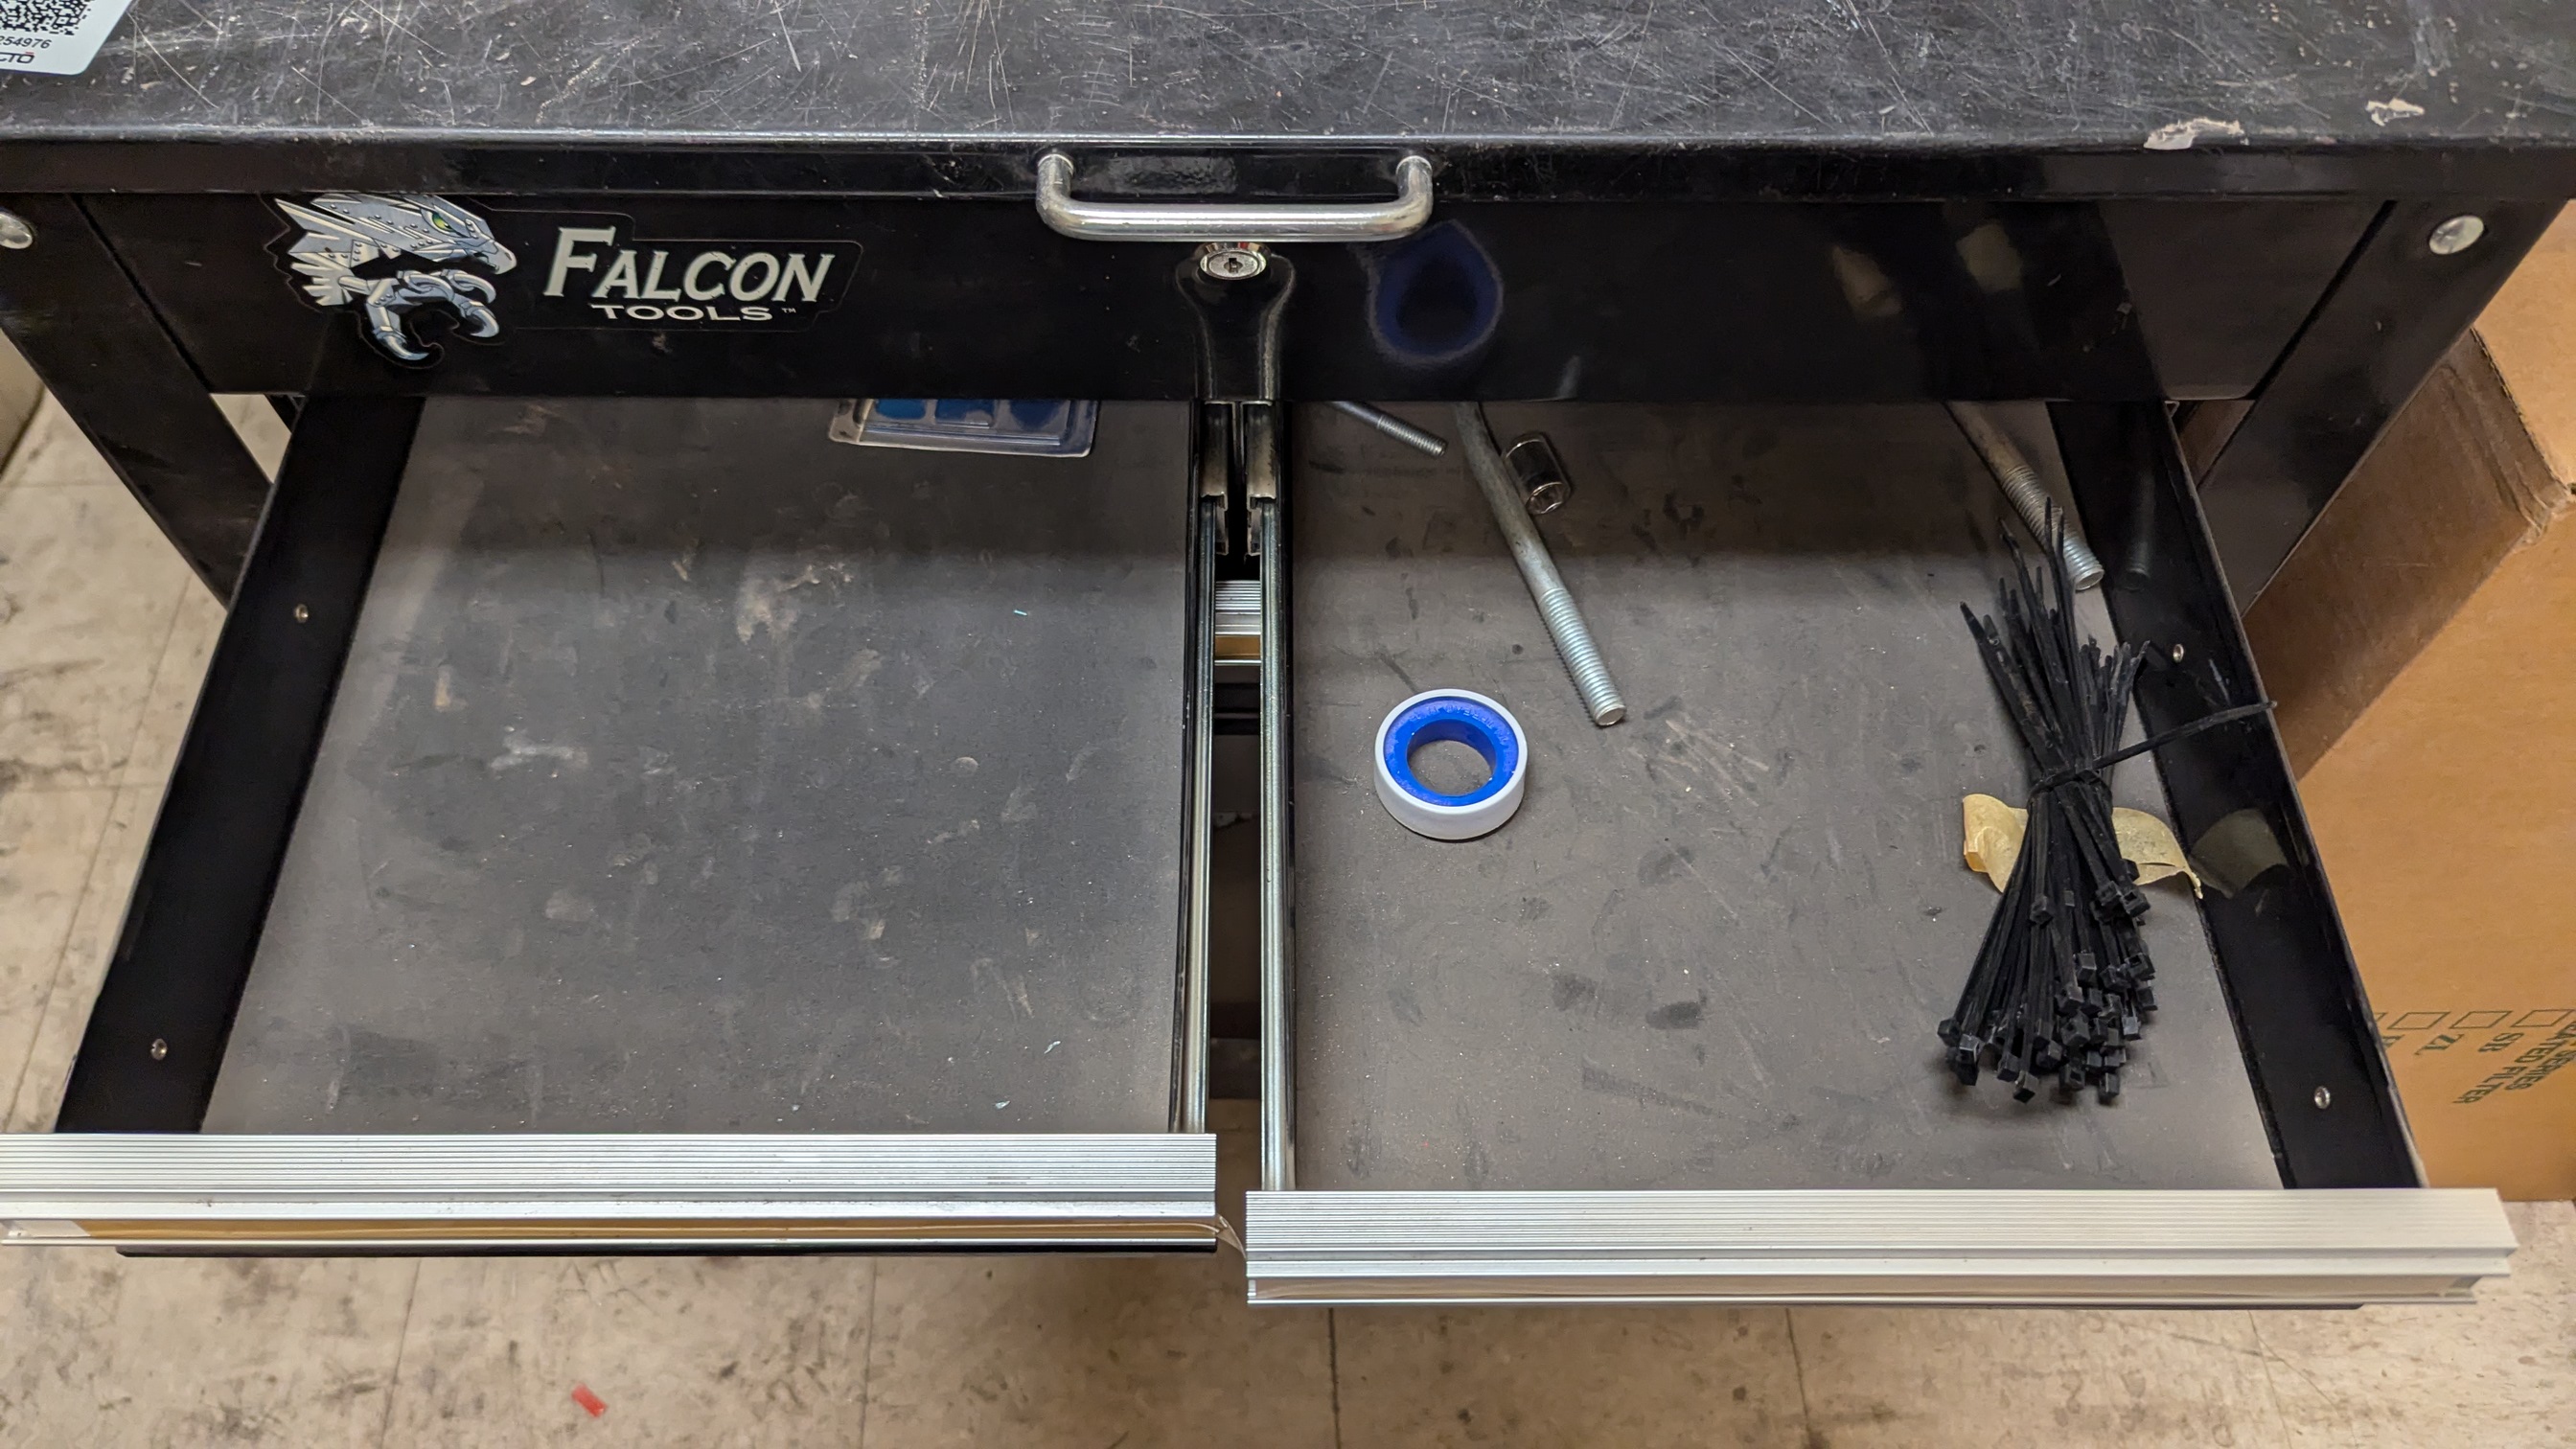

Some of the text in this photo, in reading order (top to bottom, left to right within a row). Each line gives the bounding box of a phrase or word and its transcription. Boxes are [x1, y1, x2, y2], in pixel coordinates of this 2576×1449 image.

[543, 225, 836, 303] FALCON
[588, 303, 772, 321] TOOLS
[2451, 1066, 2528, 1103] FILTER
